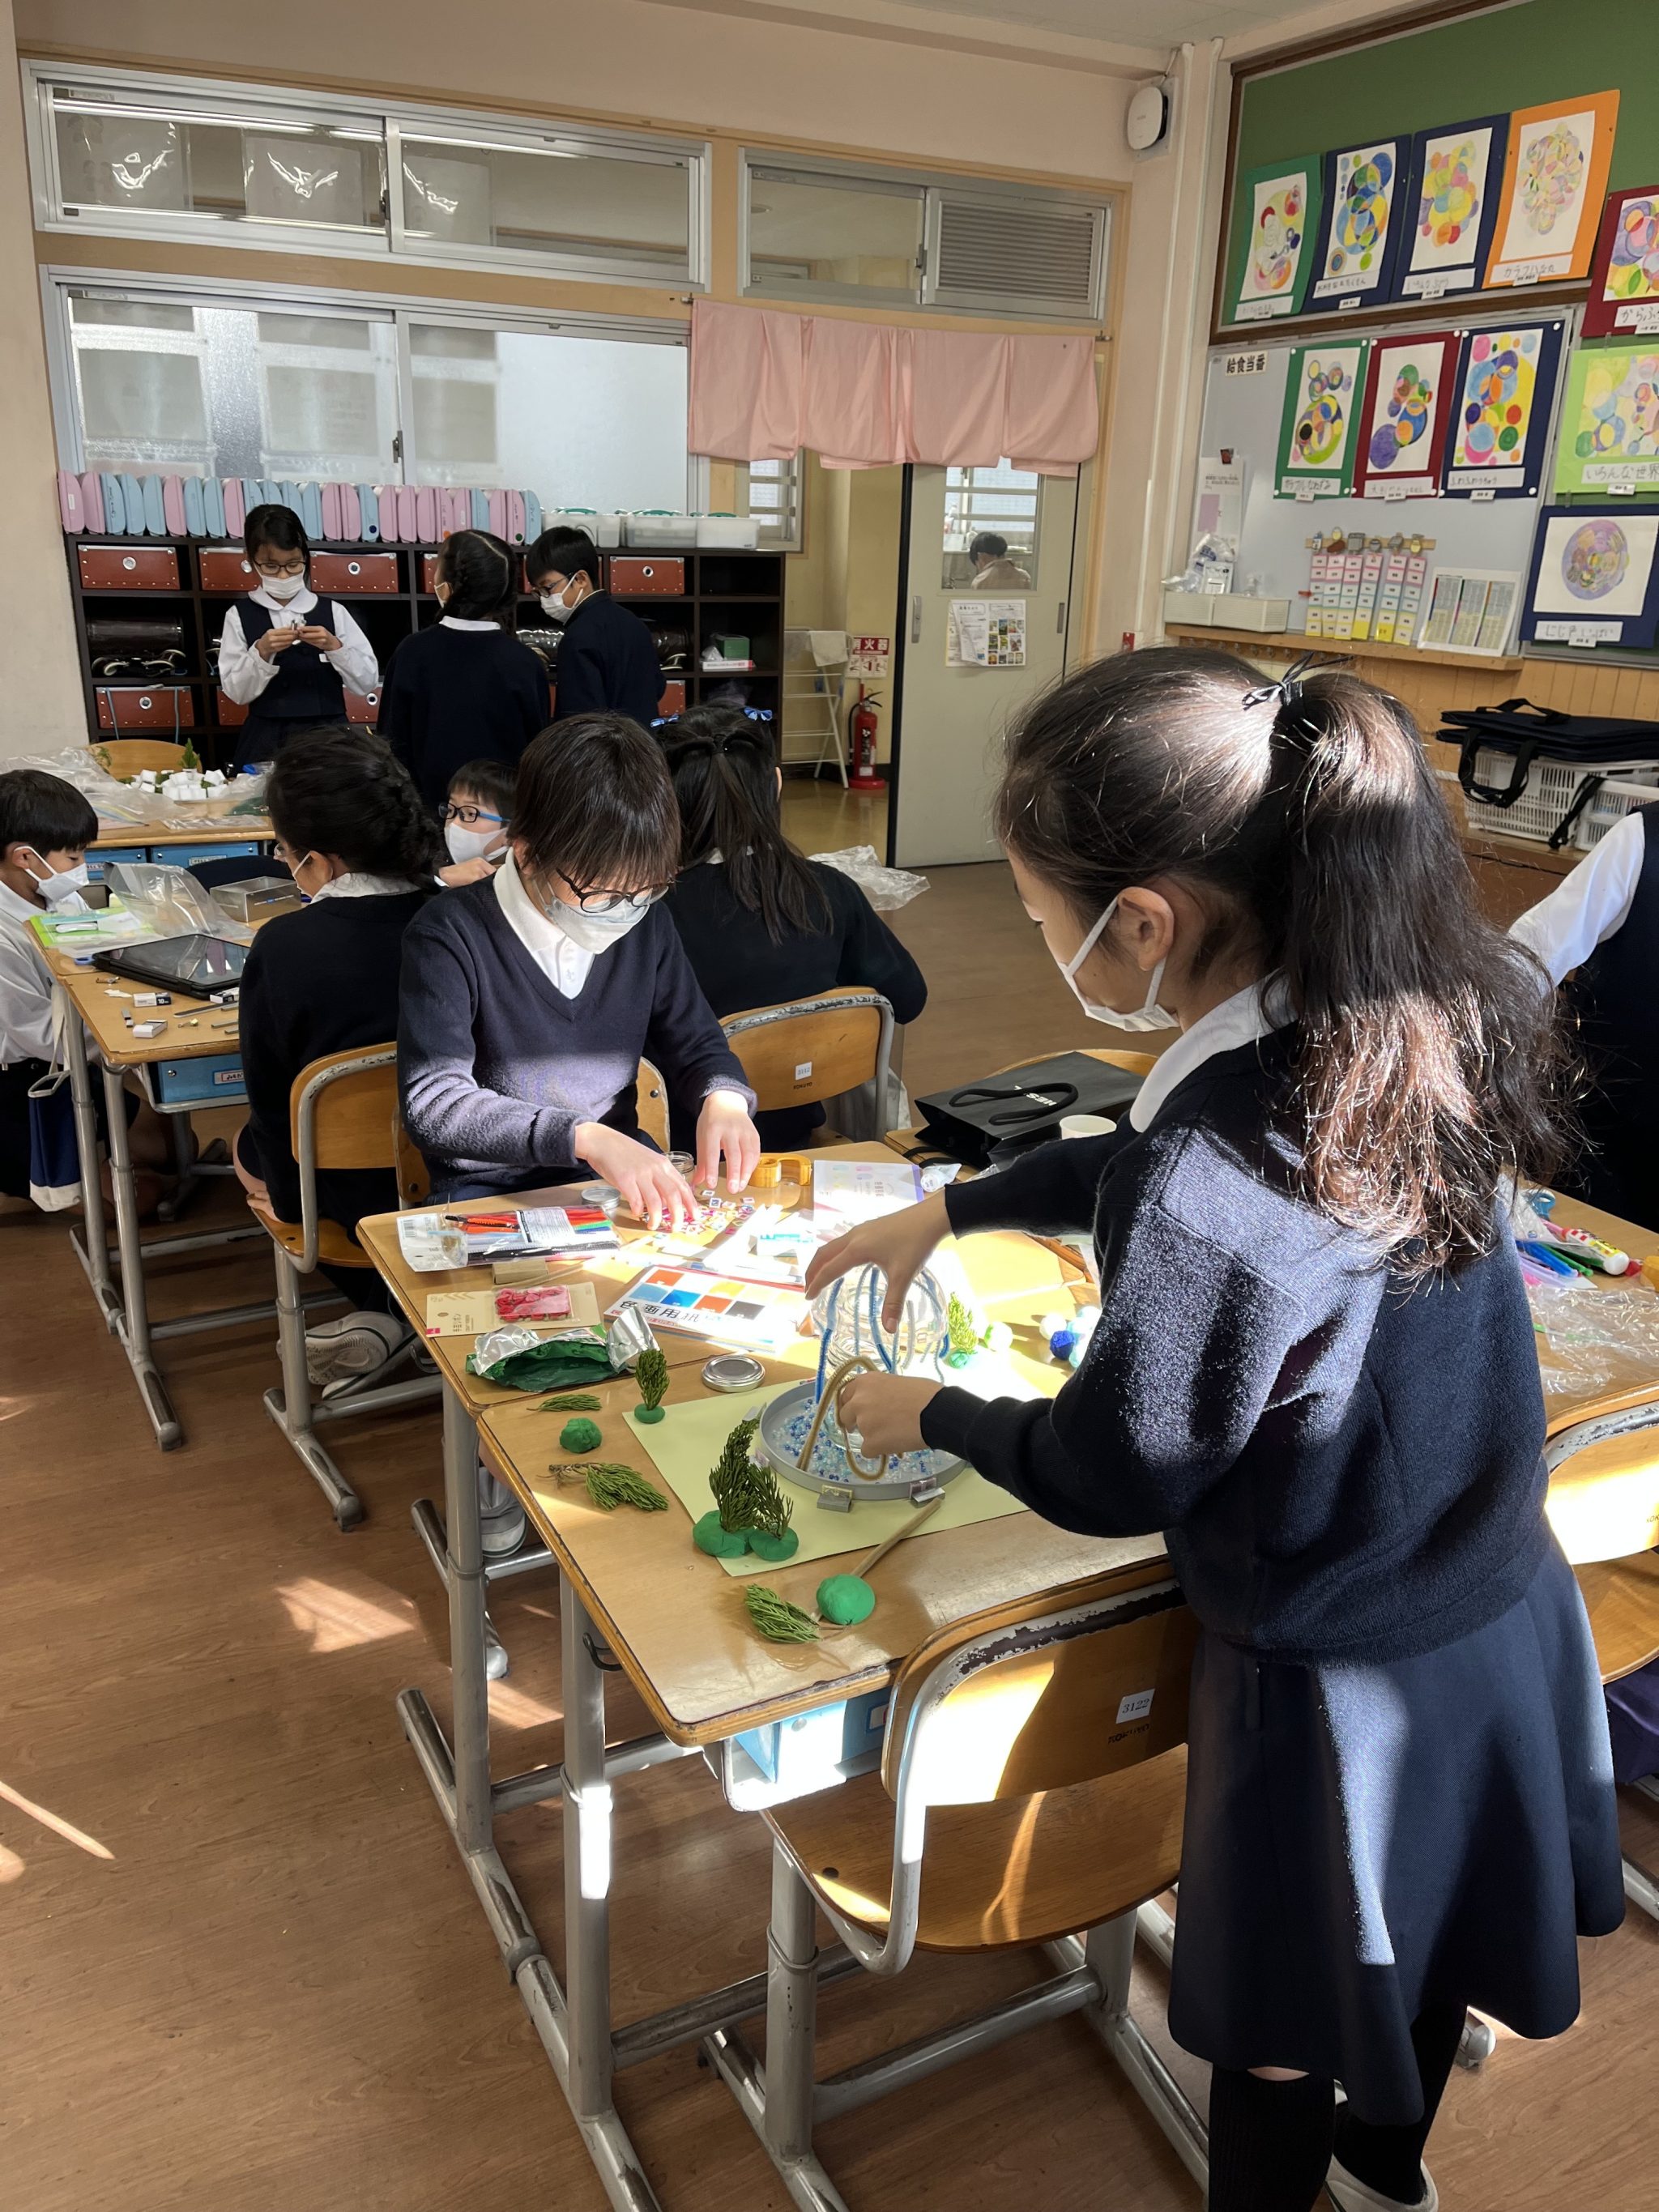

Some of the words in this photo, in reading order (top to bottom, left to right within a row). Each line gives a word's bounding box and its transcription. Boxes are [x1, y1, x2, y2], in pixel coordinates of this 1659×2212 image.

[1226, 354, 1266, 373] 給食当番
[1013, 1085, 1057, 1106] IESL
[1122, 1698, 1150, 1713] 3122
